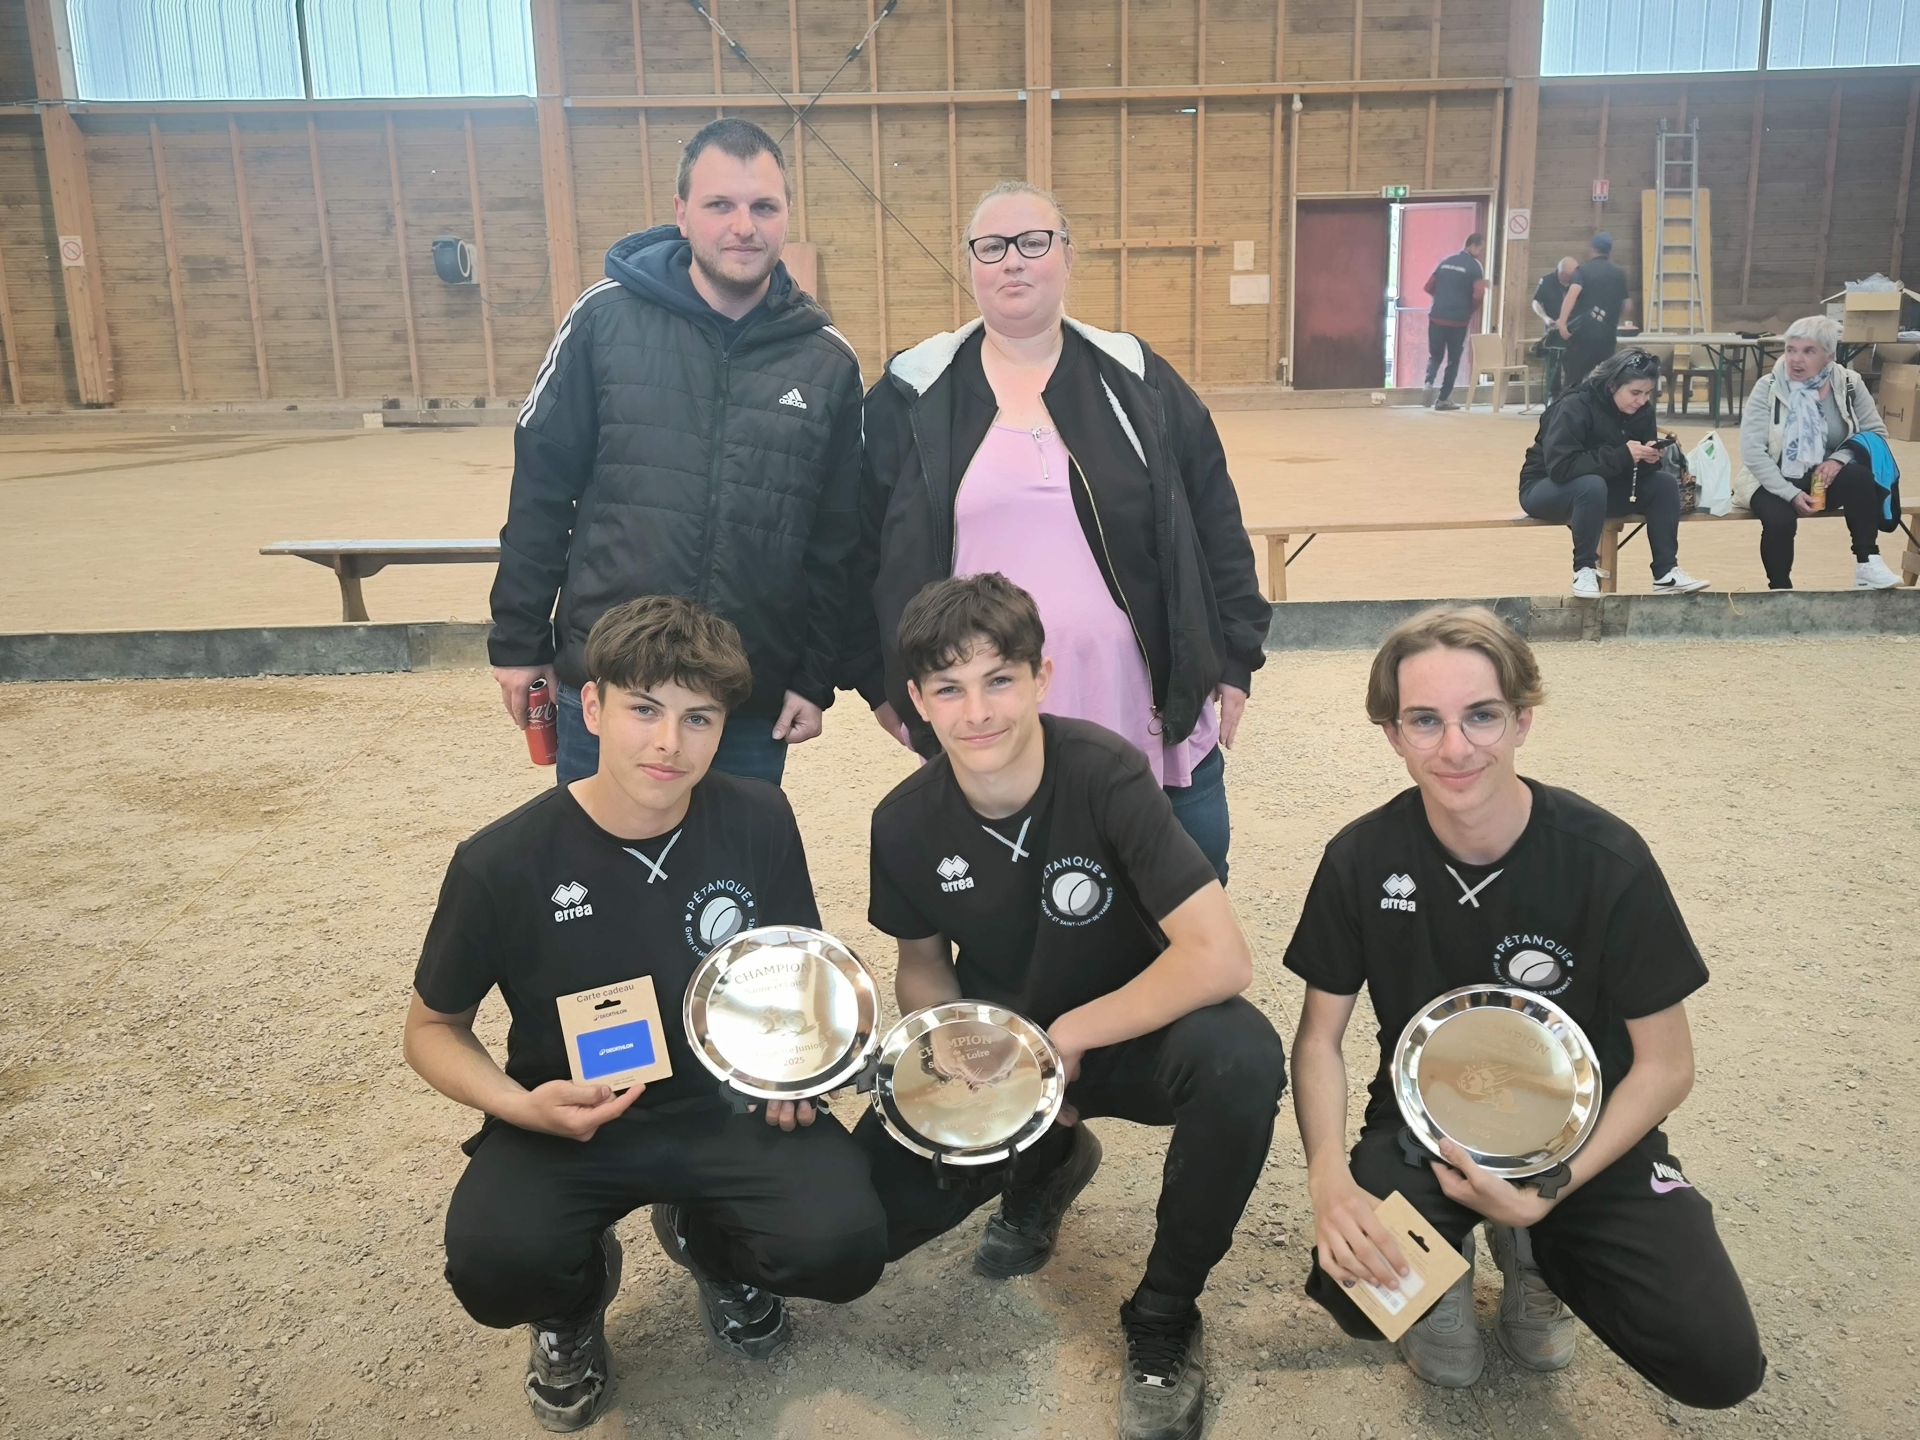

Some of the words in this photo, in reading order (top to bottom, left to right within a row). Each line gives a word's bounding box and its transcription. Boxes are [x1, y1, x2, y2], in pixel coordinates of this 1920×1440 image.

[686, 879, 752, 911] PÉTANQUE
[1496, 934, 1573, 960] PÉTANQUE
[576, 991, 601, 1003] Carte
[602, 984, 635, 997] cadeau
[599, 1009, 628, 1019] DECATHLON
[605, 1043, 634, 1054] DECATHLON
[966, 1049, 990, 1060] Loire
